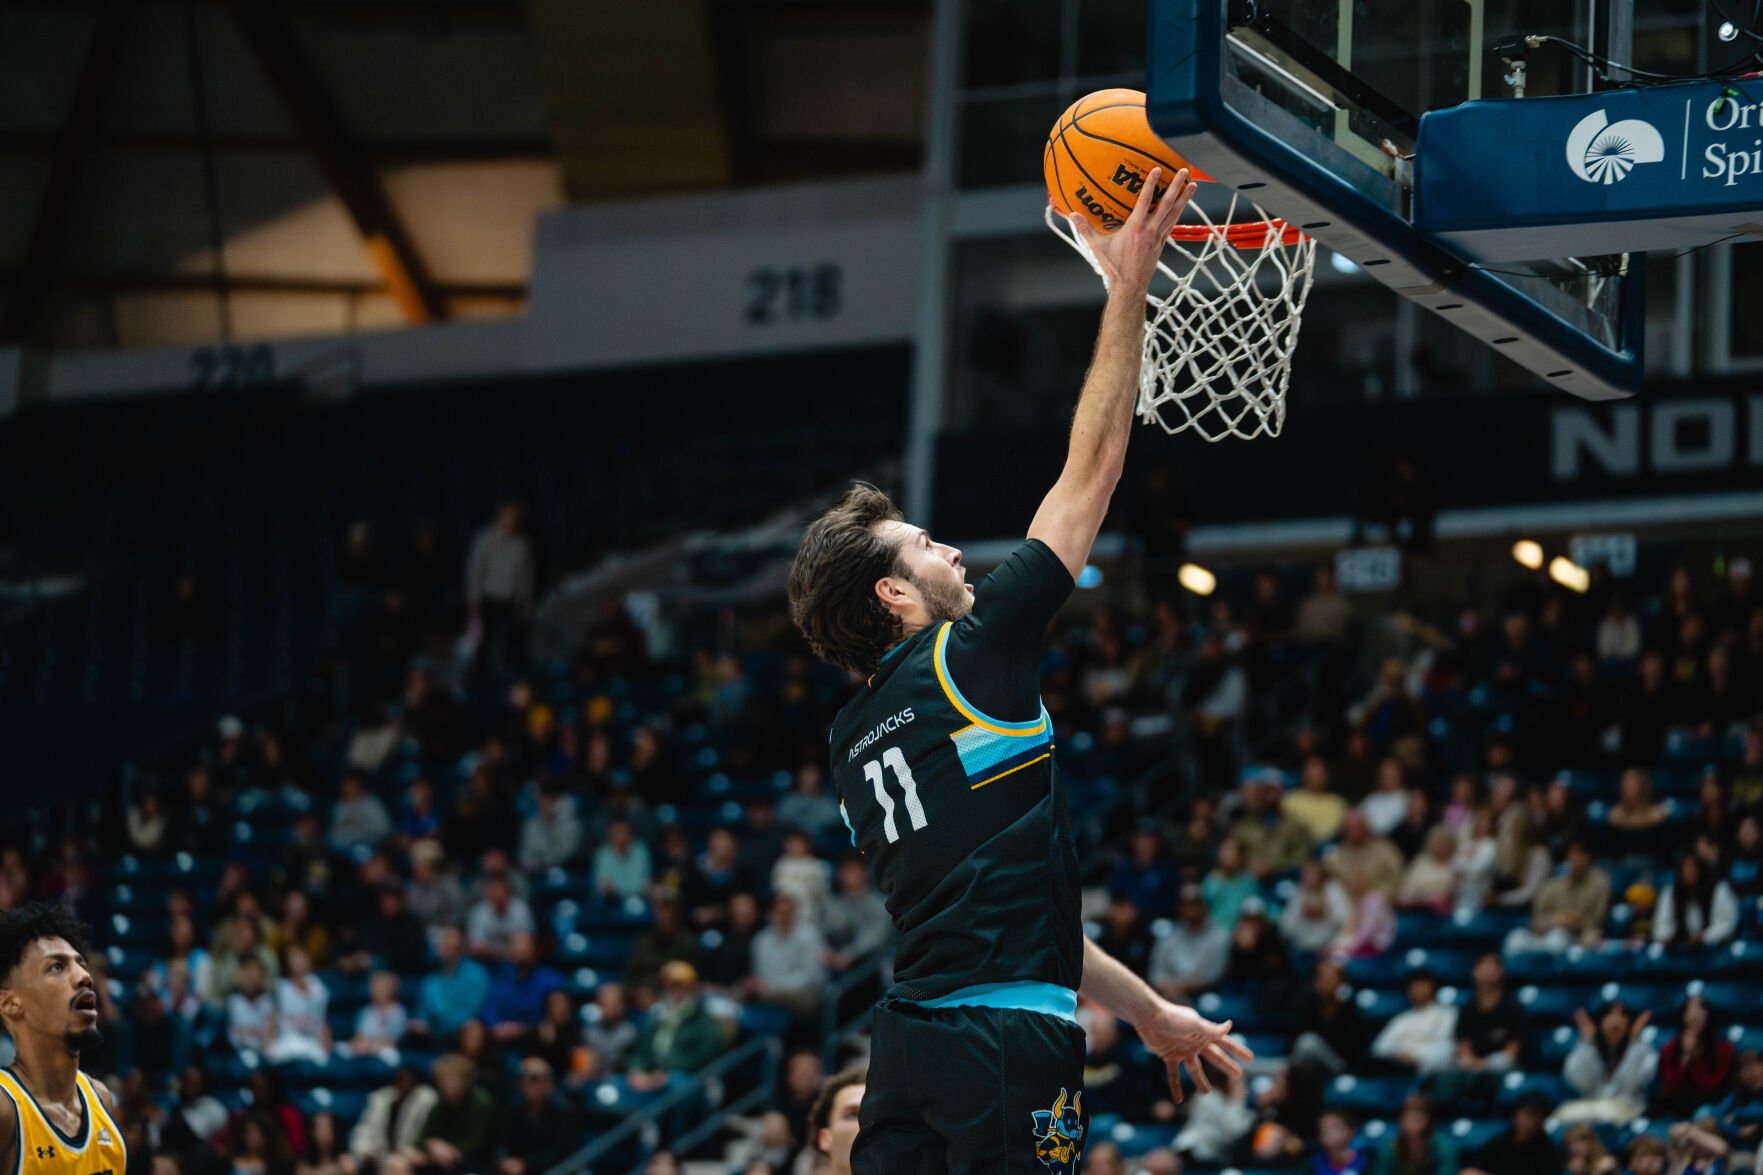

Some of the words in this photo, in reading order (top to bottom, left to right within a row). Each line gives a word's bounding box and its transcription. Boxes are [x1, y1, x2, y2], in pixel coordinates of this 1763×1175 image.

[1702, 139, 1763, 187] Spi
[1074, 184, 1126, 231] lson
[747, 262, 843, 326] 218
[1553, 398, 1763, 477] NO
[848, 707, 915, 763] ASTROJACKS
[863, 746, 928, 844] 11
